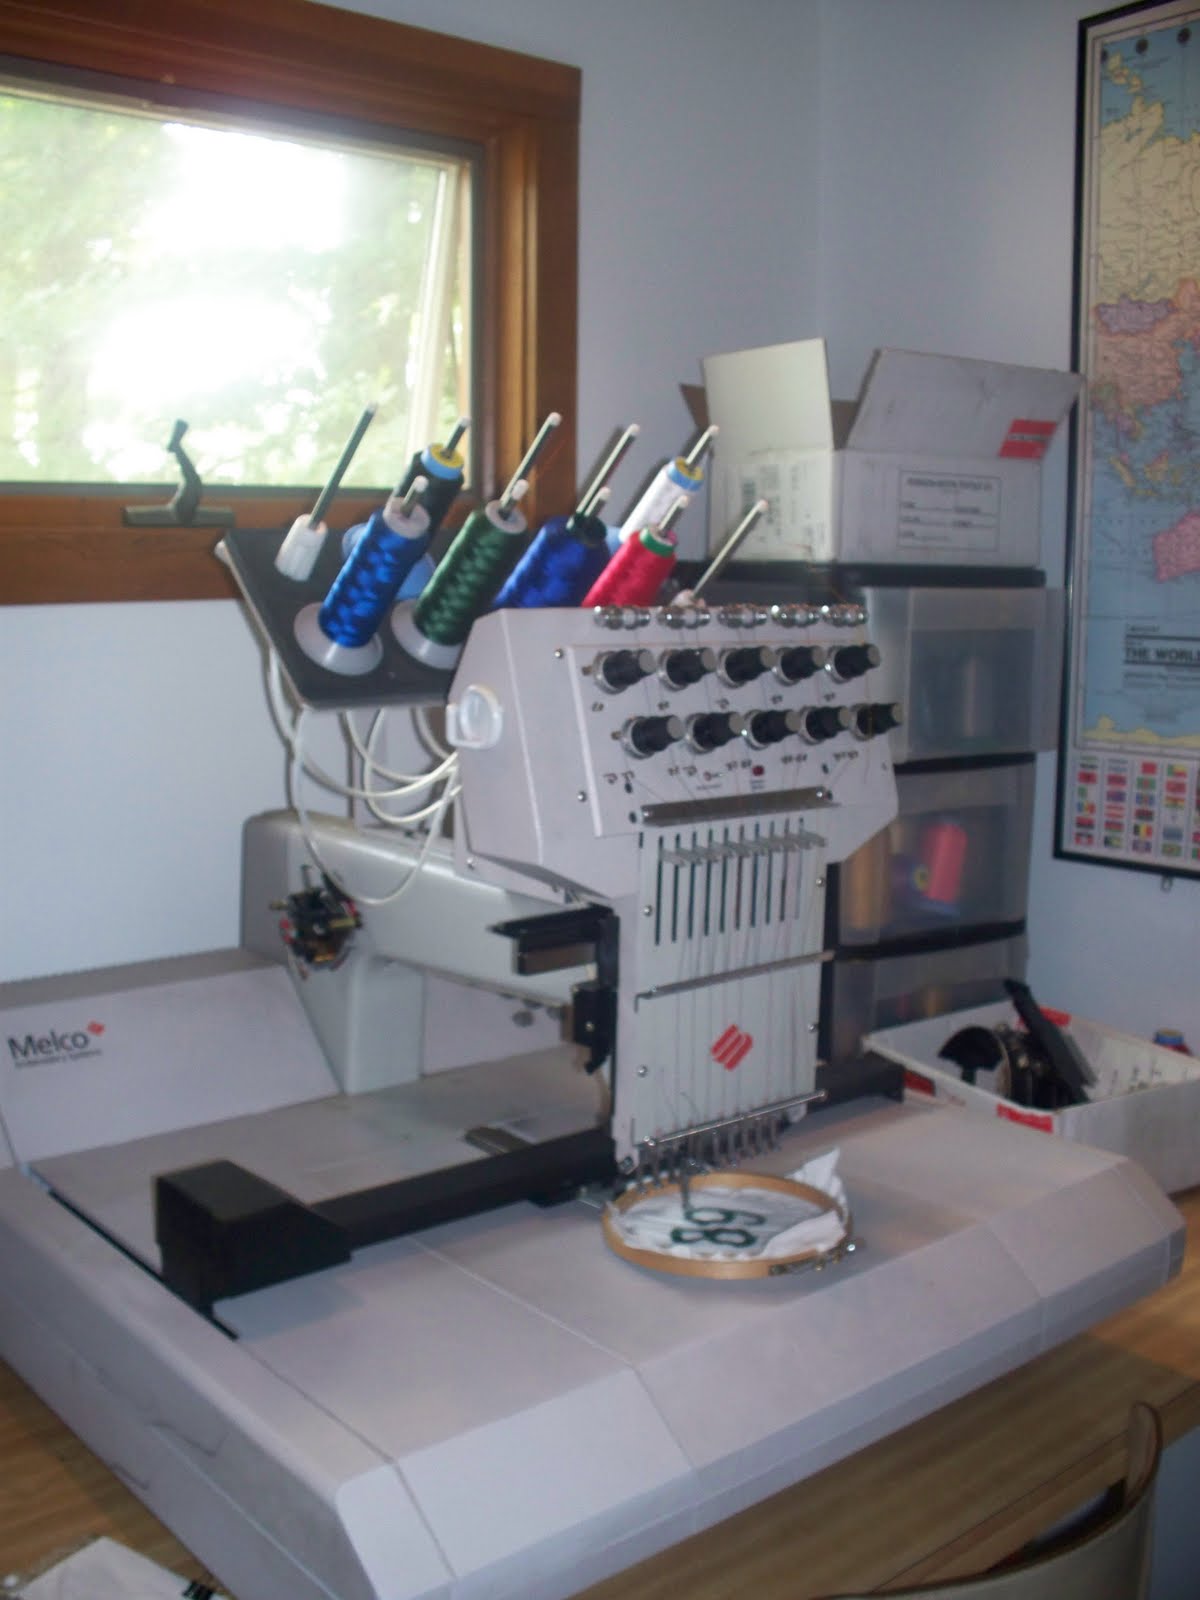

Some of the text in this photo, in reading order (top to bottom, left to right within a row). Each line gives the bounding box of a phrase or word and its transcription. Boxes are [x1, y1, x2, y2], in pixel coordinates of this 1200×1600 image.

[1125, 647, 1200, 663] THE WORL
[8, 1030, 90, 1058] Melco
